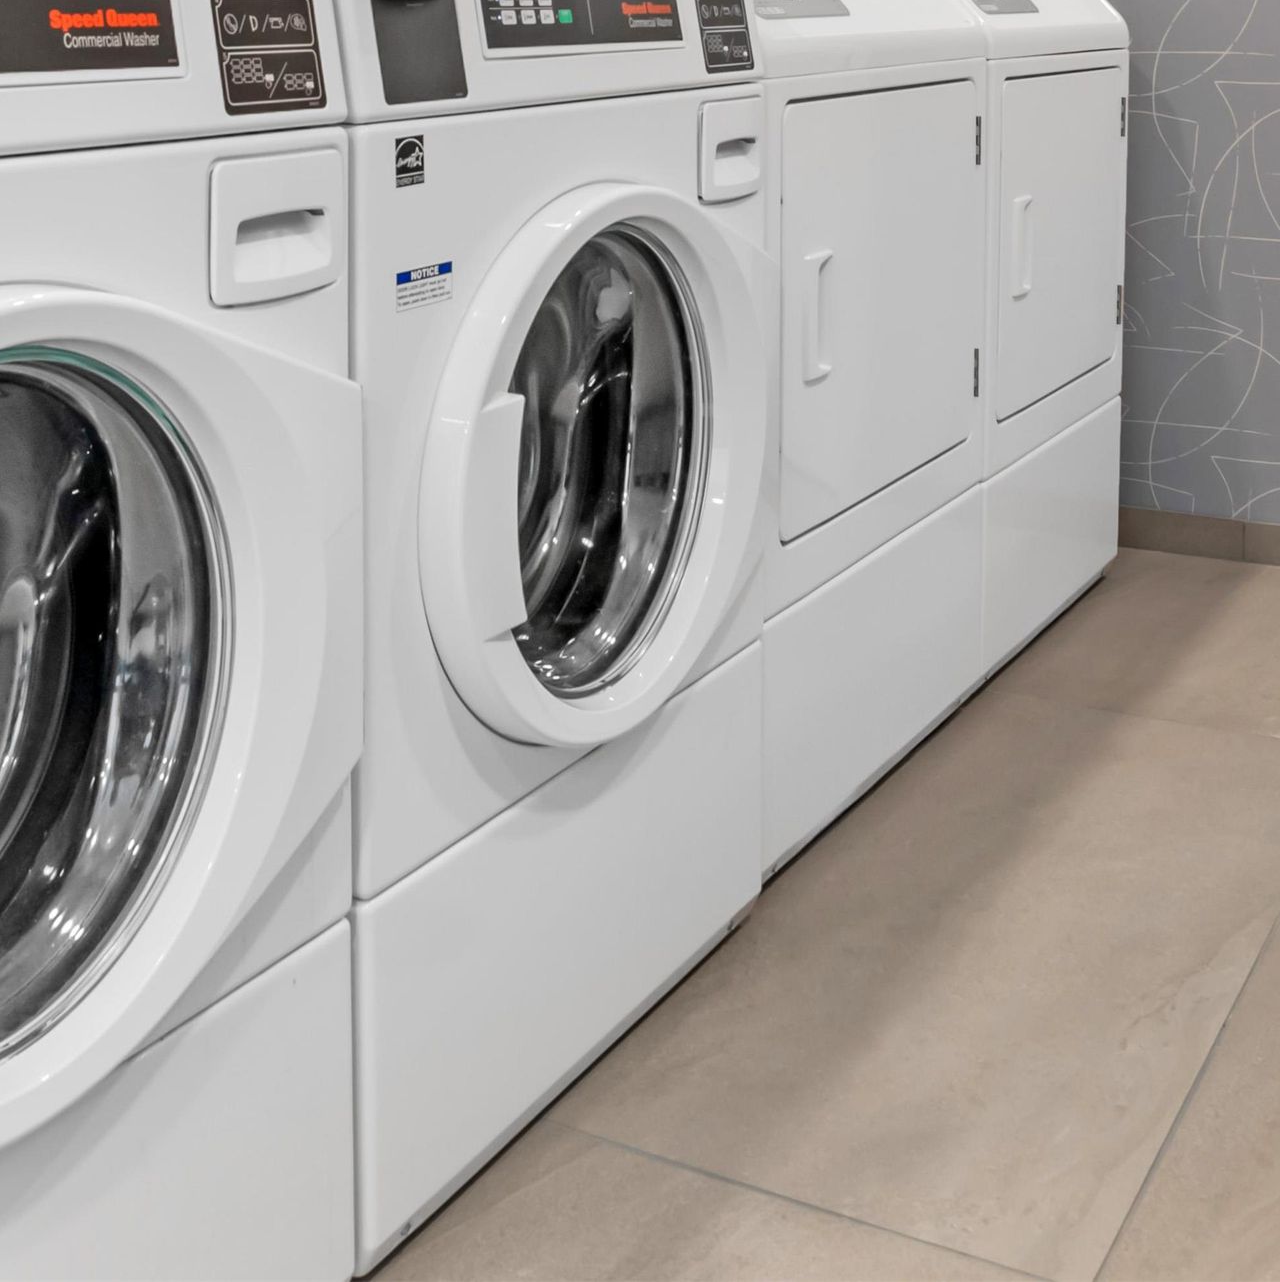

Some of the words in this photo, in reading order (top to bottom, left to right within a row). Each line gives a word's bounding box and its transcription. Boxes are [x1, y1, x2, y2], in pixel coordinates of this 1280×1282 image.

[49, 9, 104, 32] Speed
[106, 9, 159, 27] Queen
[63, 32, 122, 48] Commercial
[124, 32, 159, 46] Washer
[410, 265, 439, 281] NOTICE
